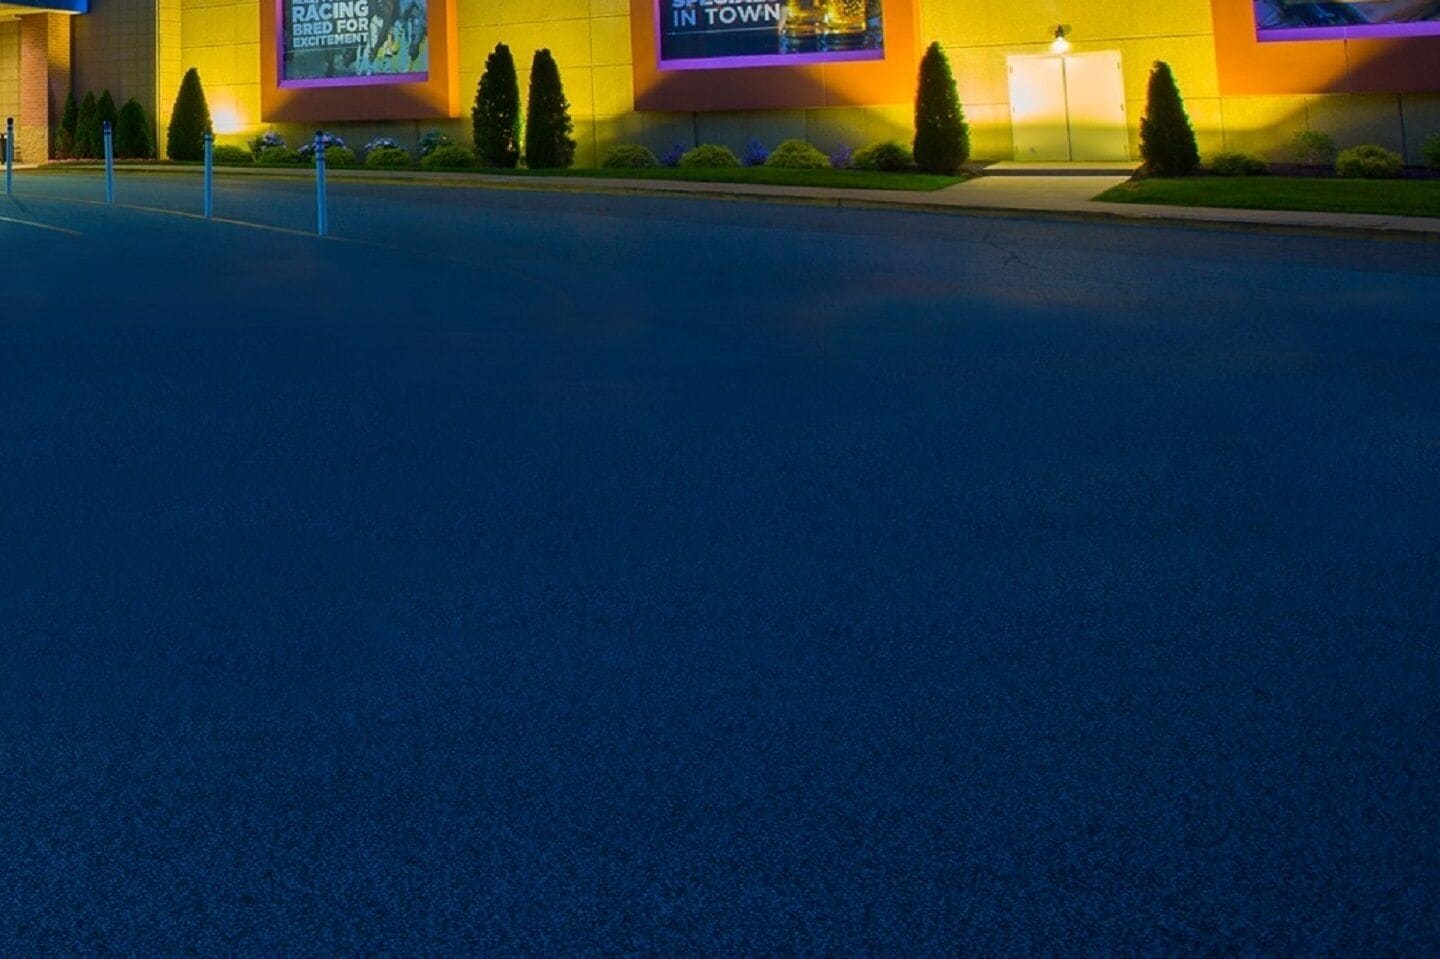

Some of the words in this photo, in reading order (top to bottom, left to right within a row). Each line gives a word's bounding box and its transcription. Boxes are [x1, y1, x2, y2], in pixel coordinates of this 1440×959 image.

[292, 0, 369, 23] RACING
[673, 9, 695, 27] IN
[705, 3, 779, 25] TOWN
[293, 21, 332, 36] BRED
[337, 16, 368, 33] FOR
[293, 33, 369, 48] EXCITEMENT
